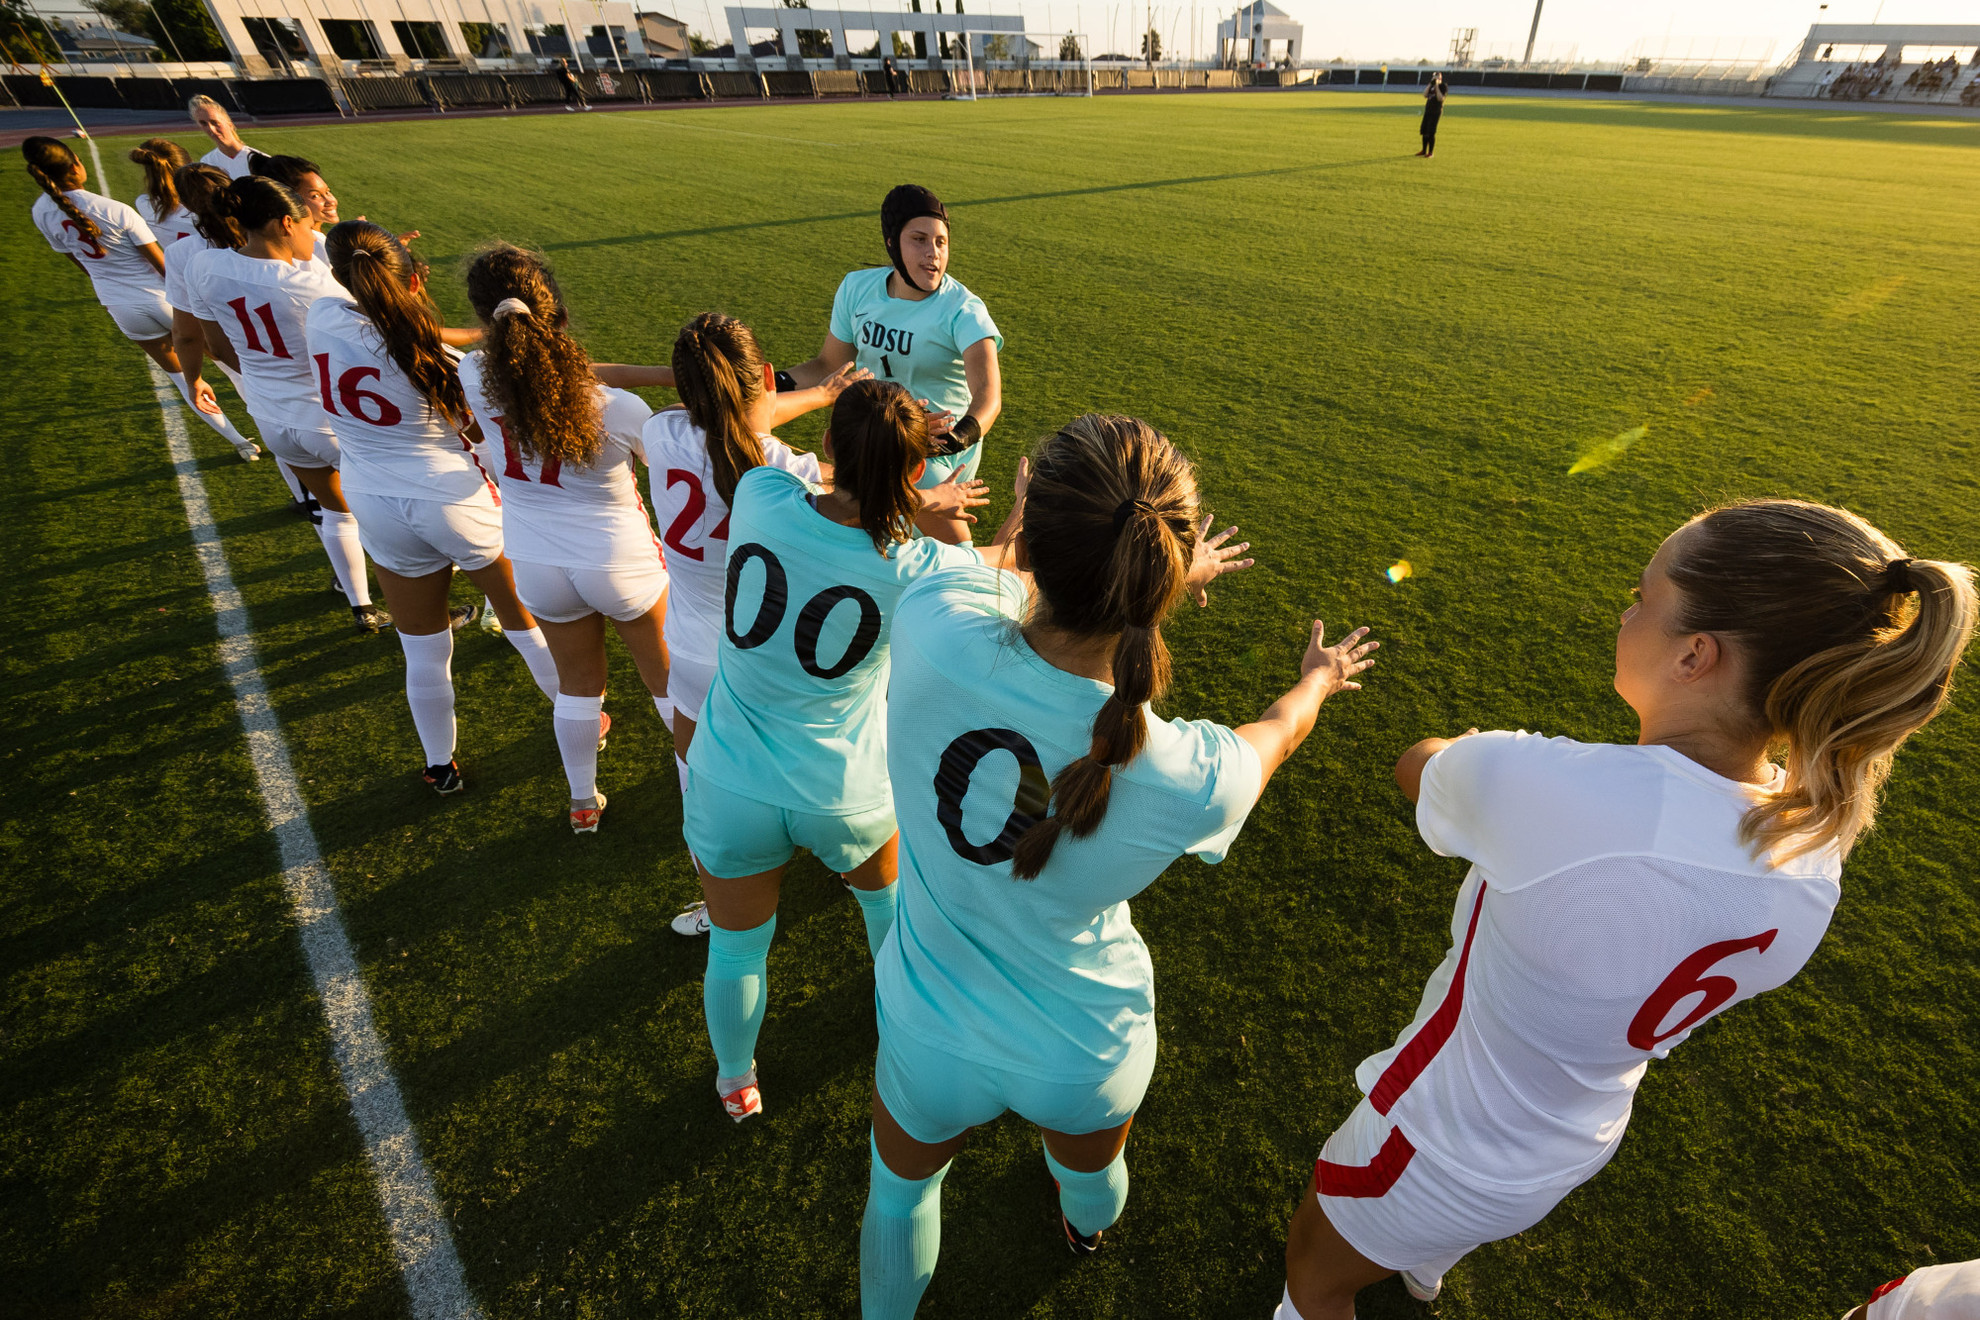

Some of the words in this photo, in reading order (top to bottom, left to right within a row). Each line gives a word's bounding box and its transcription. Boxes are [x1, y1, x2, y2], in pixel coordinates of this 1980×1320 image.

[61, 219, 106, 259] 3
[227, 296, 294, 359] 11
[862, 320, 914, 356] SDSU
[313, 352, 402, 427] 16
[880, 354, 895, 378] 1
[725, 542, 881, 680] 00
[933, 728, 1051, 866] 0
[1627, 928, 1779, 1051] 6
